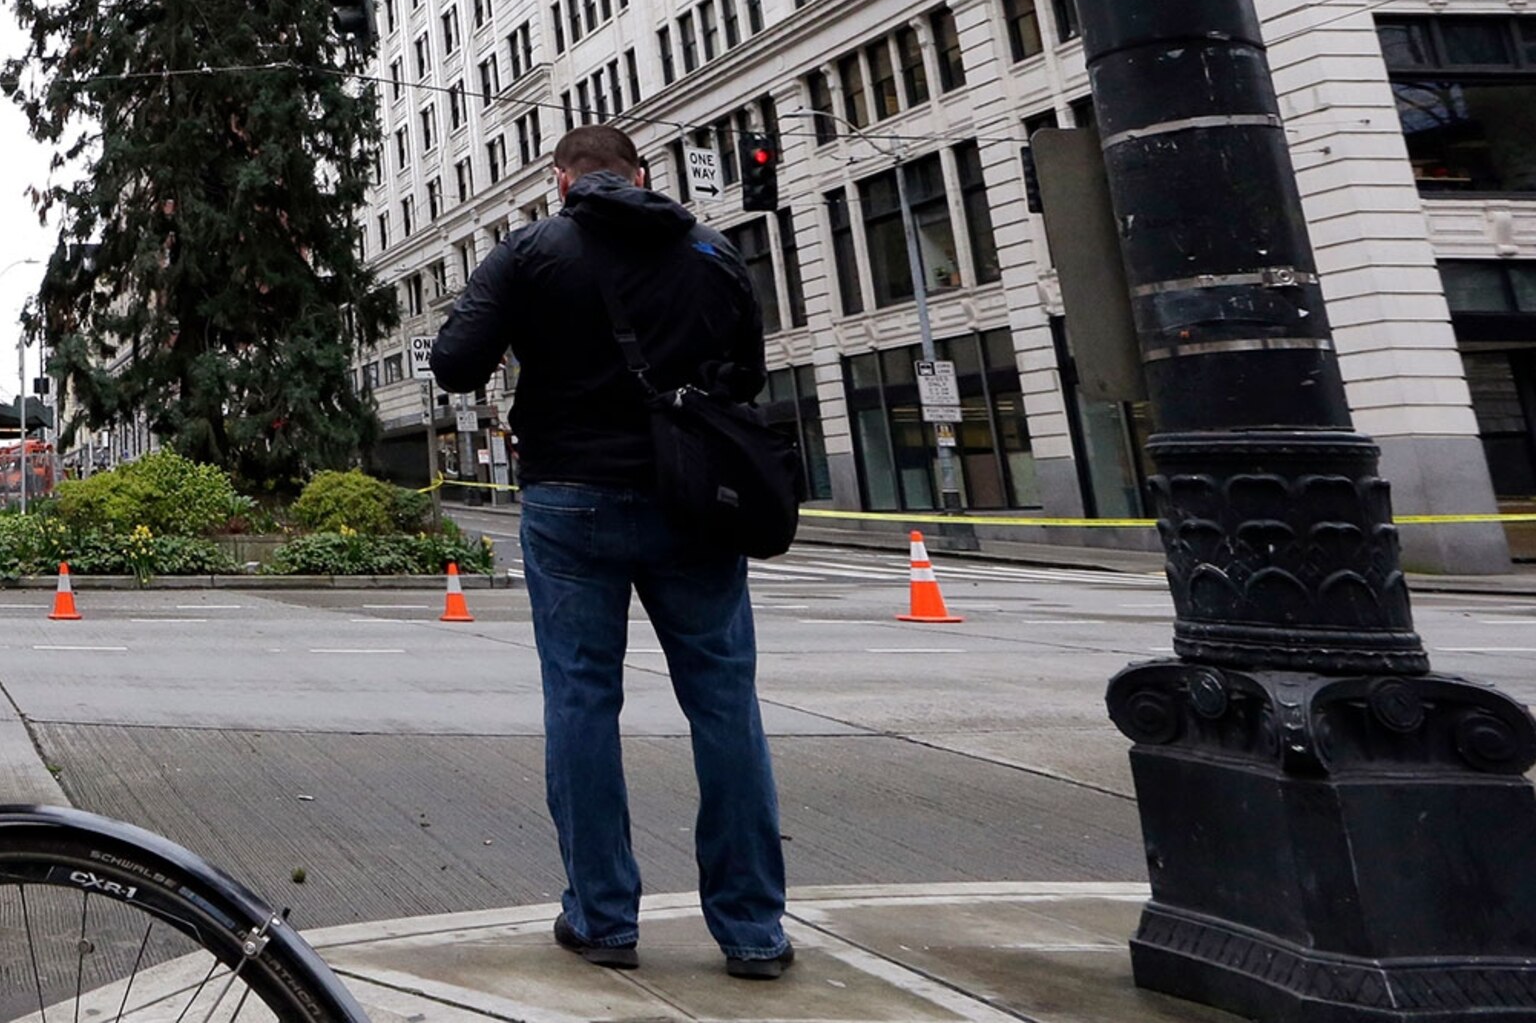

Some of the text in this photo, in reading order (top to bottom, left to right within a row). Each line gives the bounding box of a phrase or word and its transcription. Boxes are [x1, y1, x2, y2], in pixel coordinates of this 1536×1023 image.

[689, 152, 715, 167] ONE
[691, 166, 716, 180] WAY
[413, 338, 434, 350] ON
[414, 350, 432, 362] WA
[69, 870, 138, 899] CXR-1
[236, 929, 322, 1016] MRATHON
